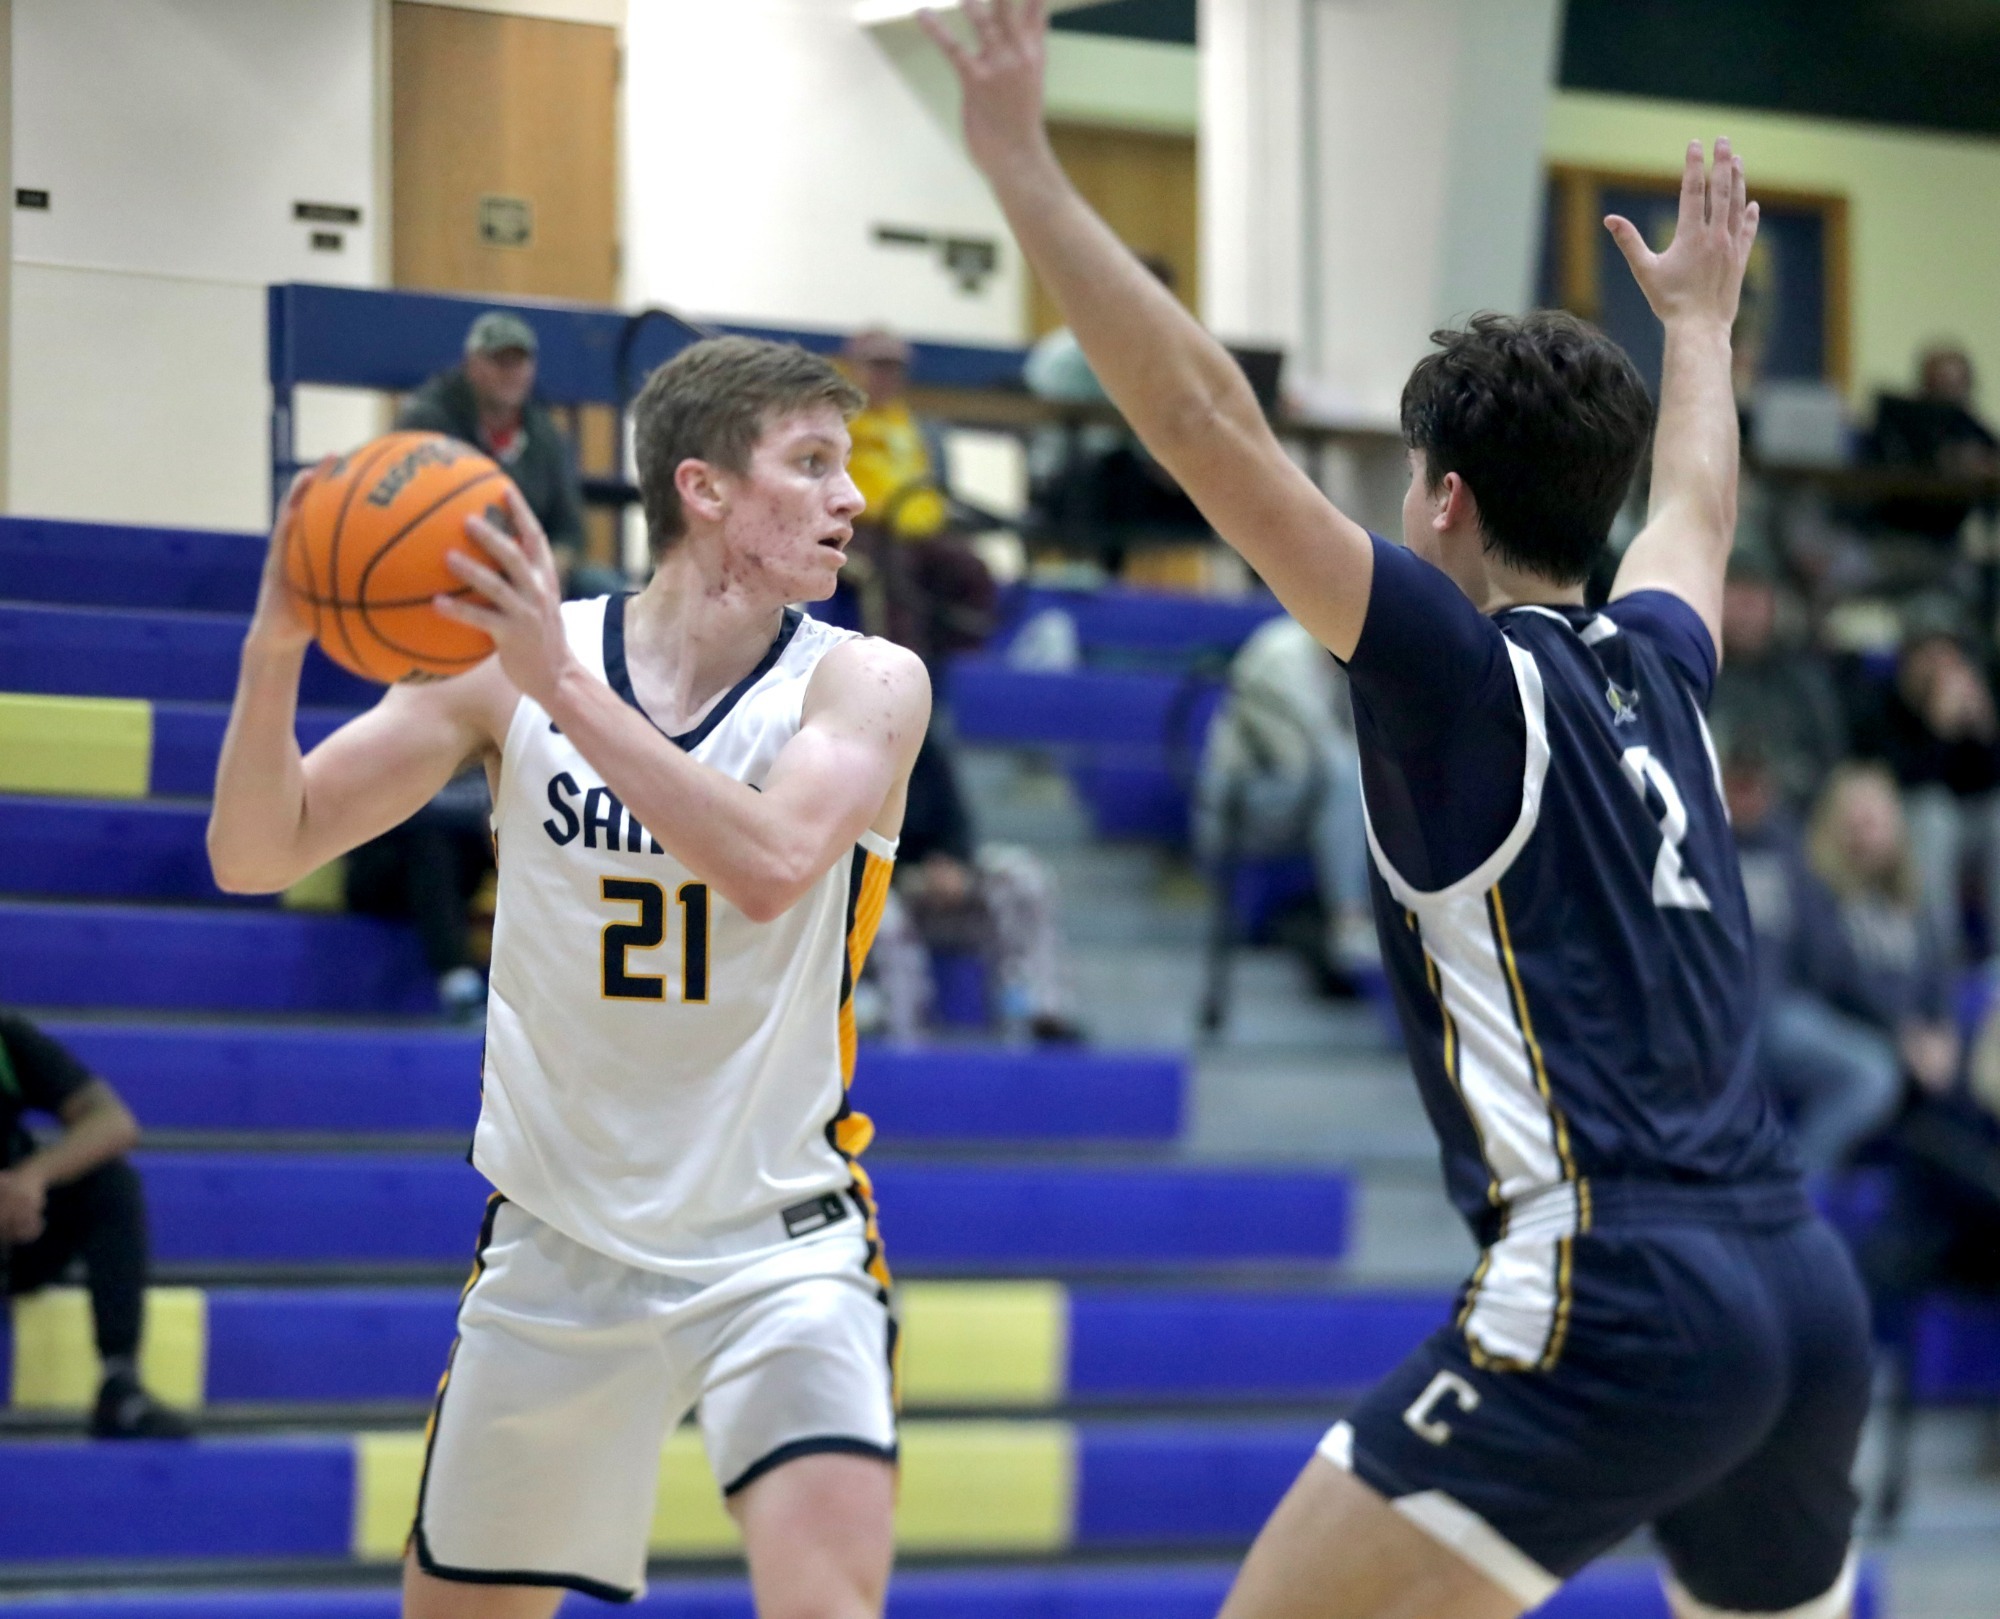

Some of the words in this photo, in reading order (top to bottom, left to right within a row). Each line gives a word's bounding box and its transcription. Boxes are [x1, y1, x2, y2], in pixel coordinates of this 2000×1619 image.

[1620, 745, 1712, 911] 2
[599, 875, 711, 1005] 21
[1402, 1369, 1480, 1446] C
